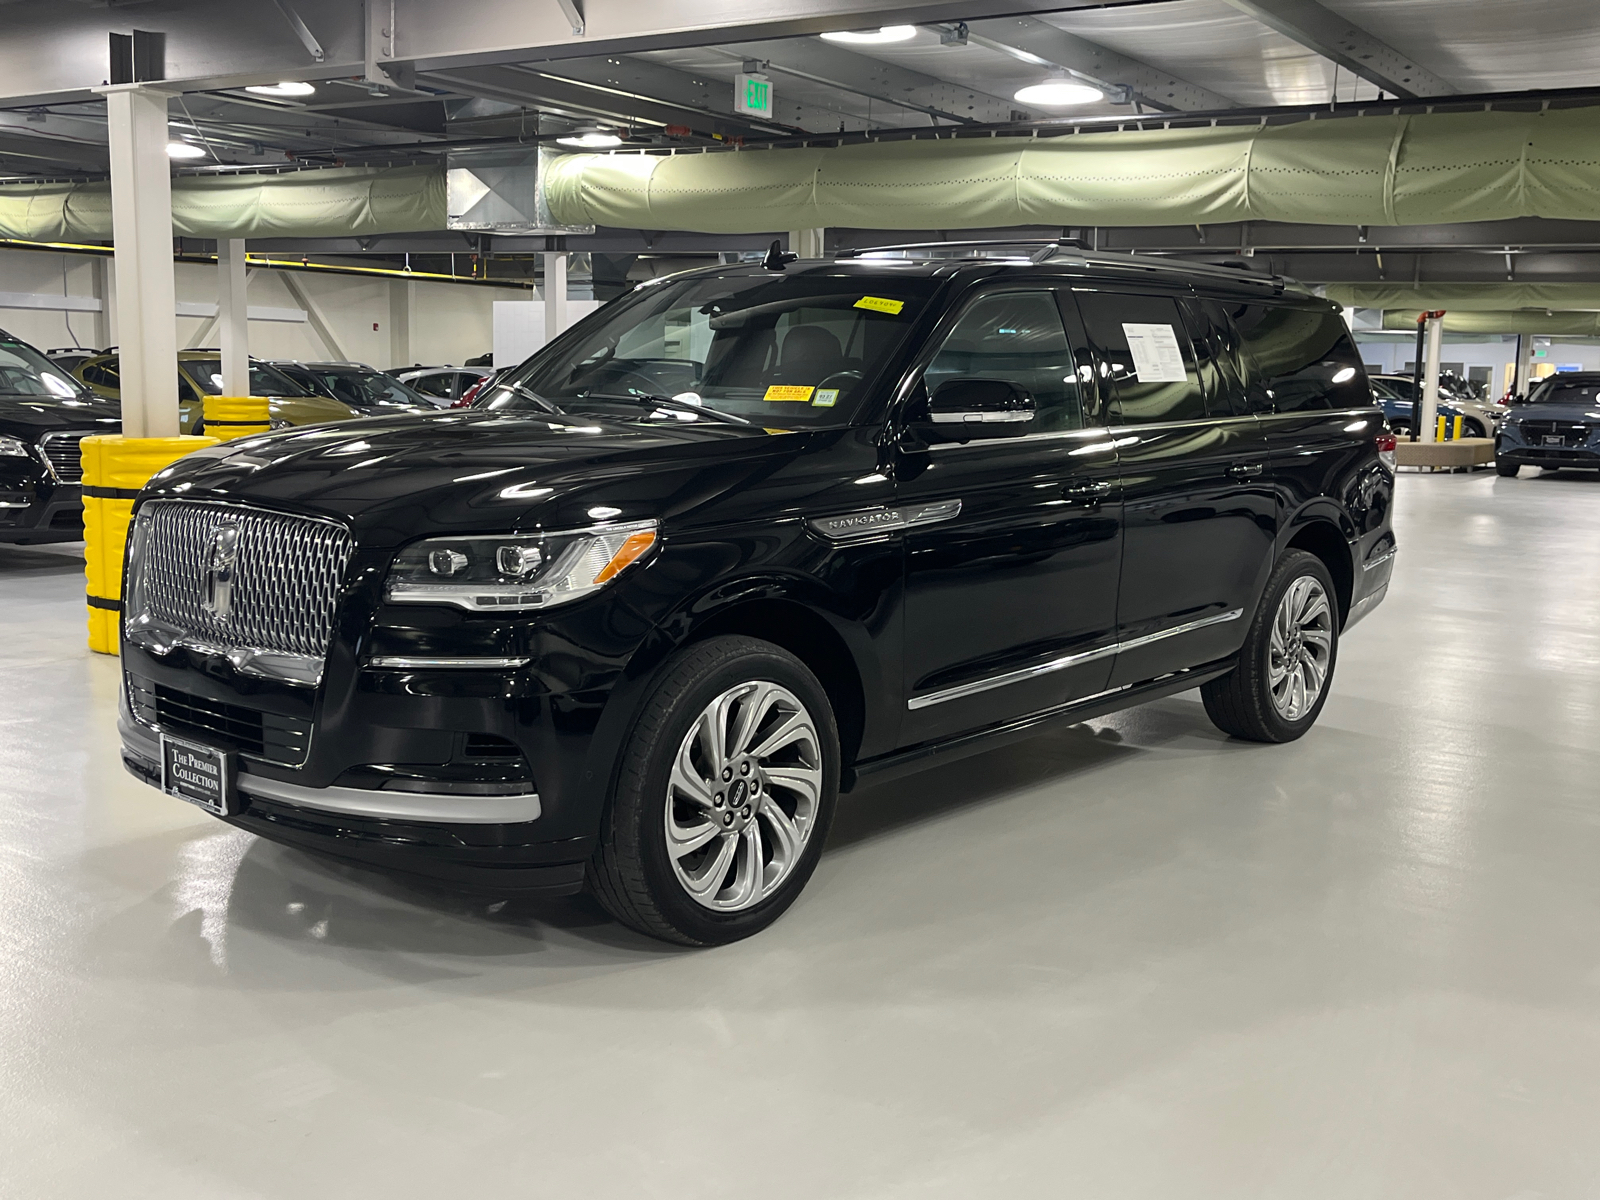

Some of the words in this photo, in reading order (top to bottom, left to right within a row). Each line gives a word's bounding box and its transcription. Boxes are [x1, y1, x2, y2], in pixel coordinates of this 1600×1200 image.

[747, 80, 768, 111] EXIT
[828, 511, 899, 530] NAVIGATOR
[172, 748, 188, 766] THE
[188, 753, 218, 776] PREMIER
[172, 762, 219, 791] COLLECTION
